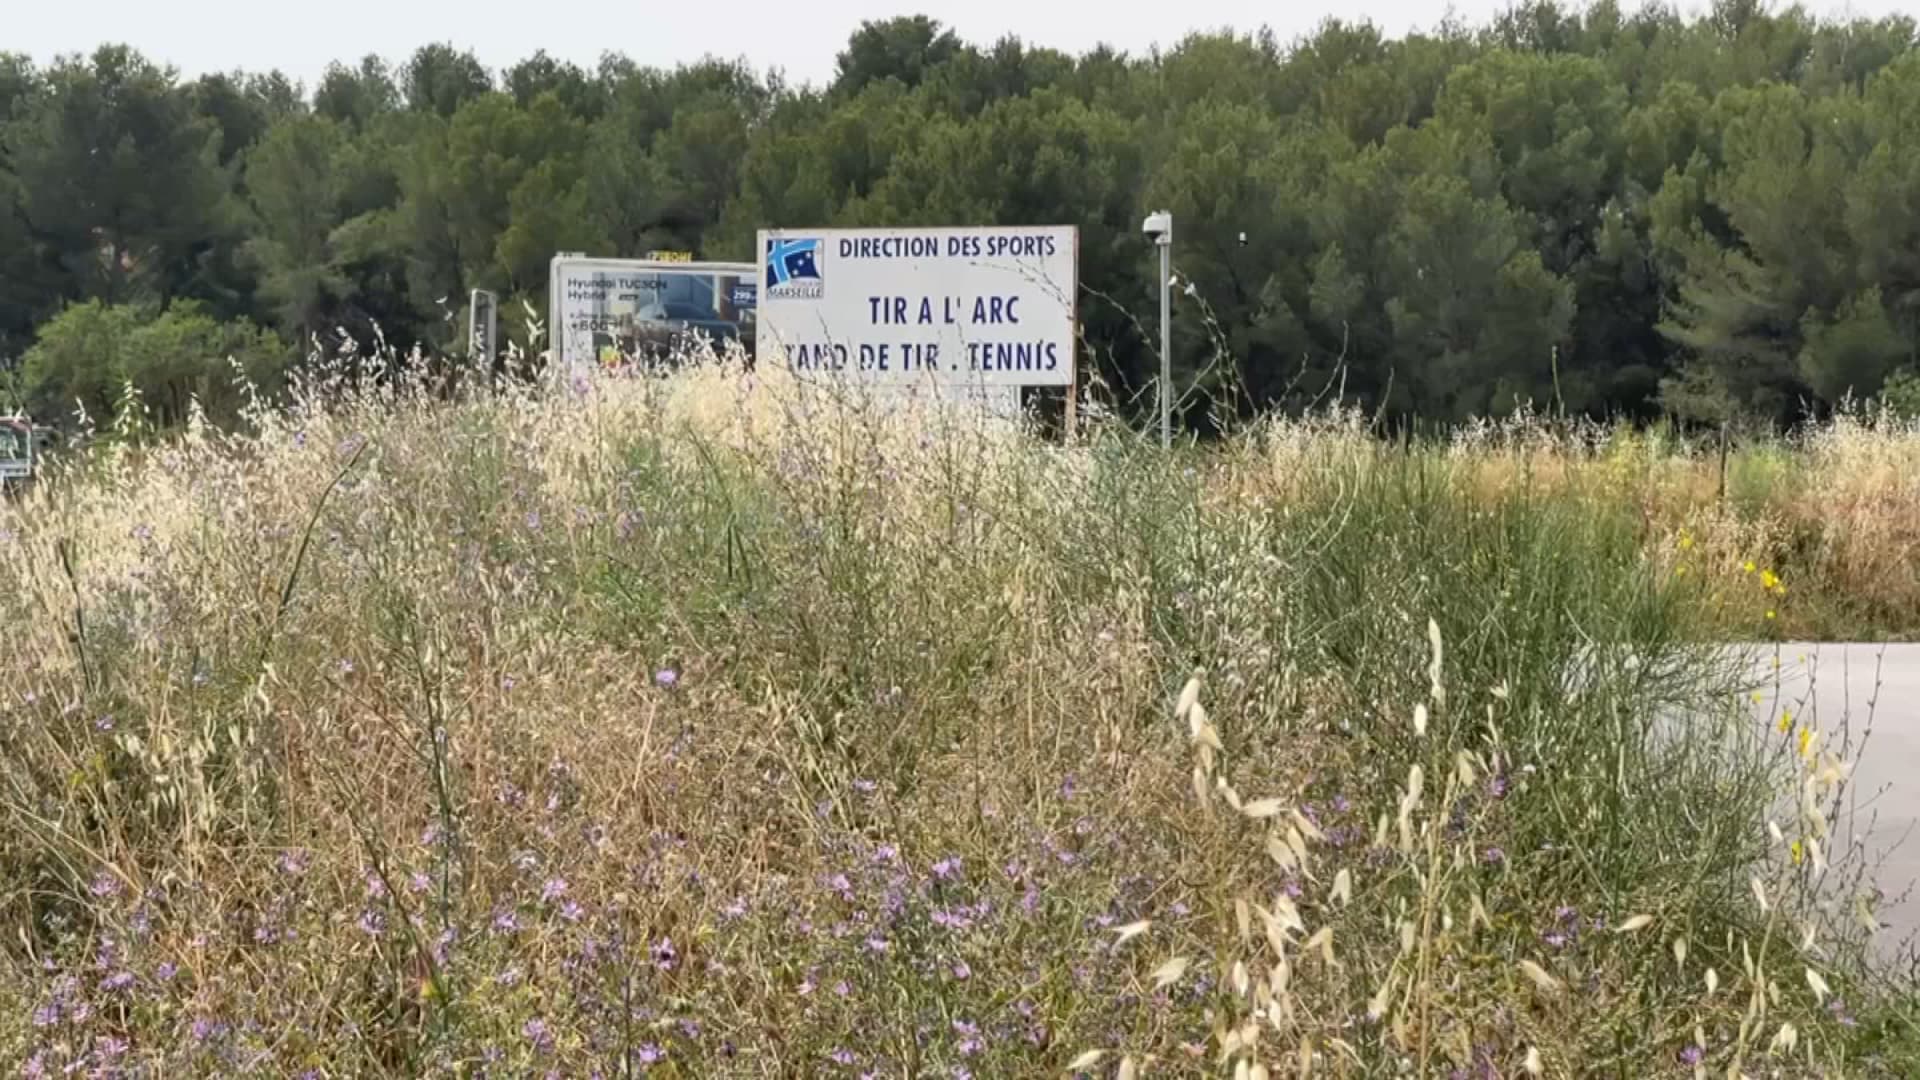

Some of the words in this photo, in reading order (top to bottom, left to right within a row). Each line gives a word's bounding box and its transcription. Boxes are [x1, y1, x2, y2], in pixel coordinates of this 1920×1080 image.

[839, 238, 938, 257] DIRECTION
[948, 237, 980, 256] DES
[987, 236, 1055, 255] SPORTS
[568, 278, 616, 291] Hyundai
[618, 279, 667, 290] TUCSON
[767, 287, 822, 297] MARSEILLE
[568, 290, 605, 301] Hybrid
[868, 296, 907, 324] TIR
[918, 296, 932, 324] A
[972, 296, 1019, 324] ARC
[860, 344, 889, 370] DE
[901, 343, 938, 371] TIR
[967, 342, 1057, 371] TENNIS
